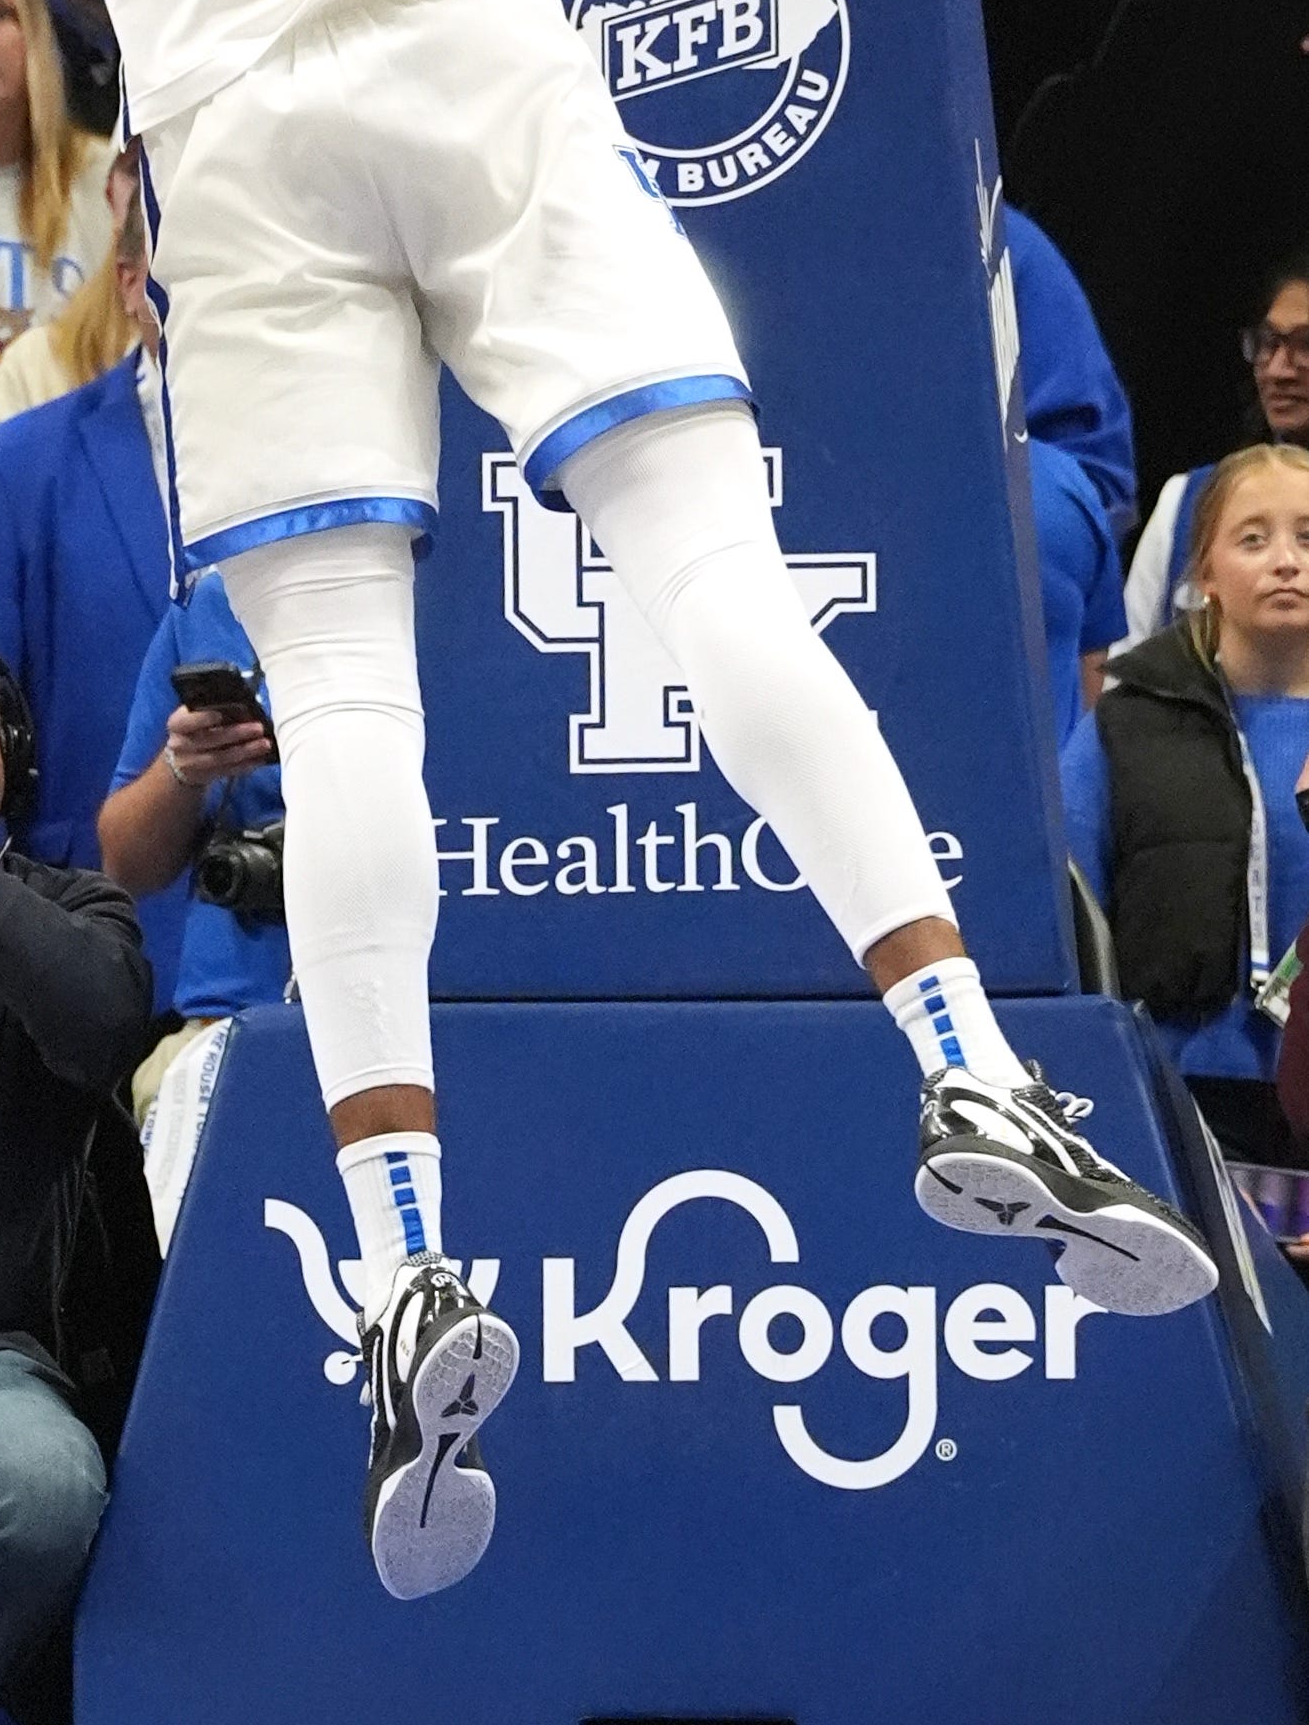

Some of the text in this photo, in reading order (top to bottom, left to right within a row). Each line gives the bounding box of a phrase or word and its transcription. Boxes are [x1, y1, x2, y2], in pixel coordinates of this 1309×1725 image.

[676, 68, 832, 193] BUREAU
[433, 801, 965, 896] HealthCe
[542, 1168, 1110, 1490] Kroger
